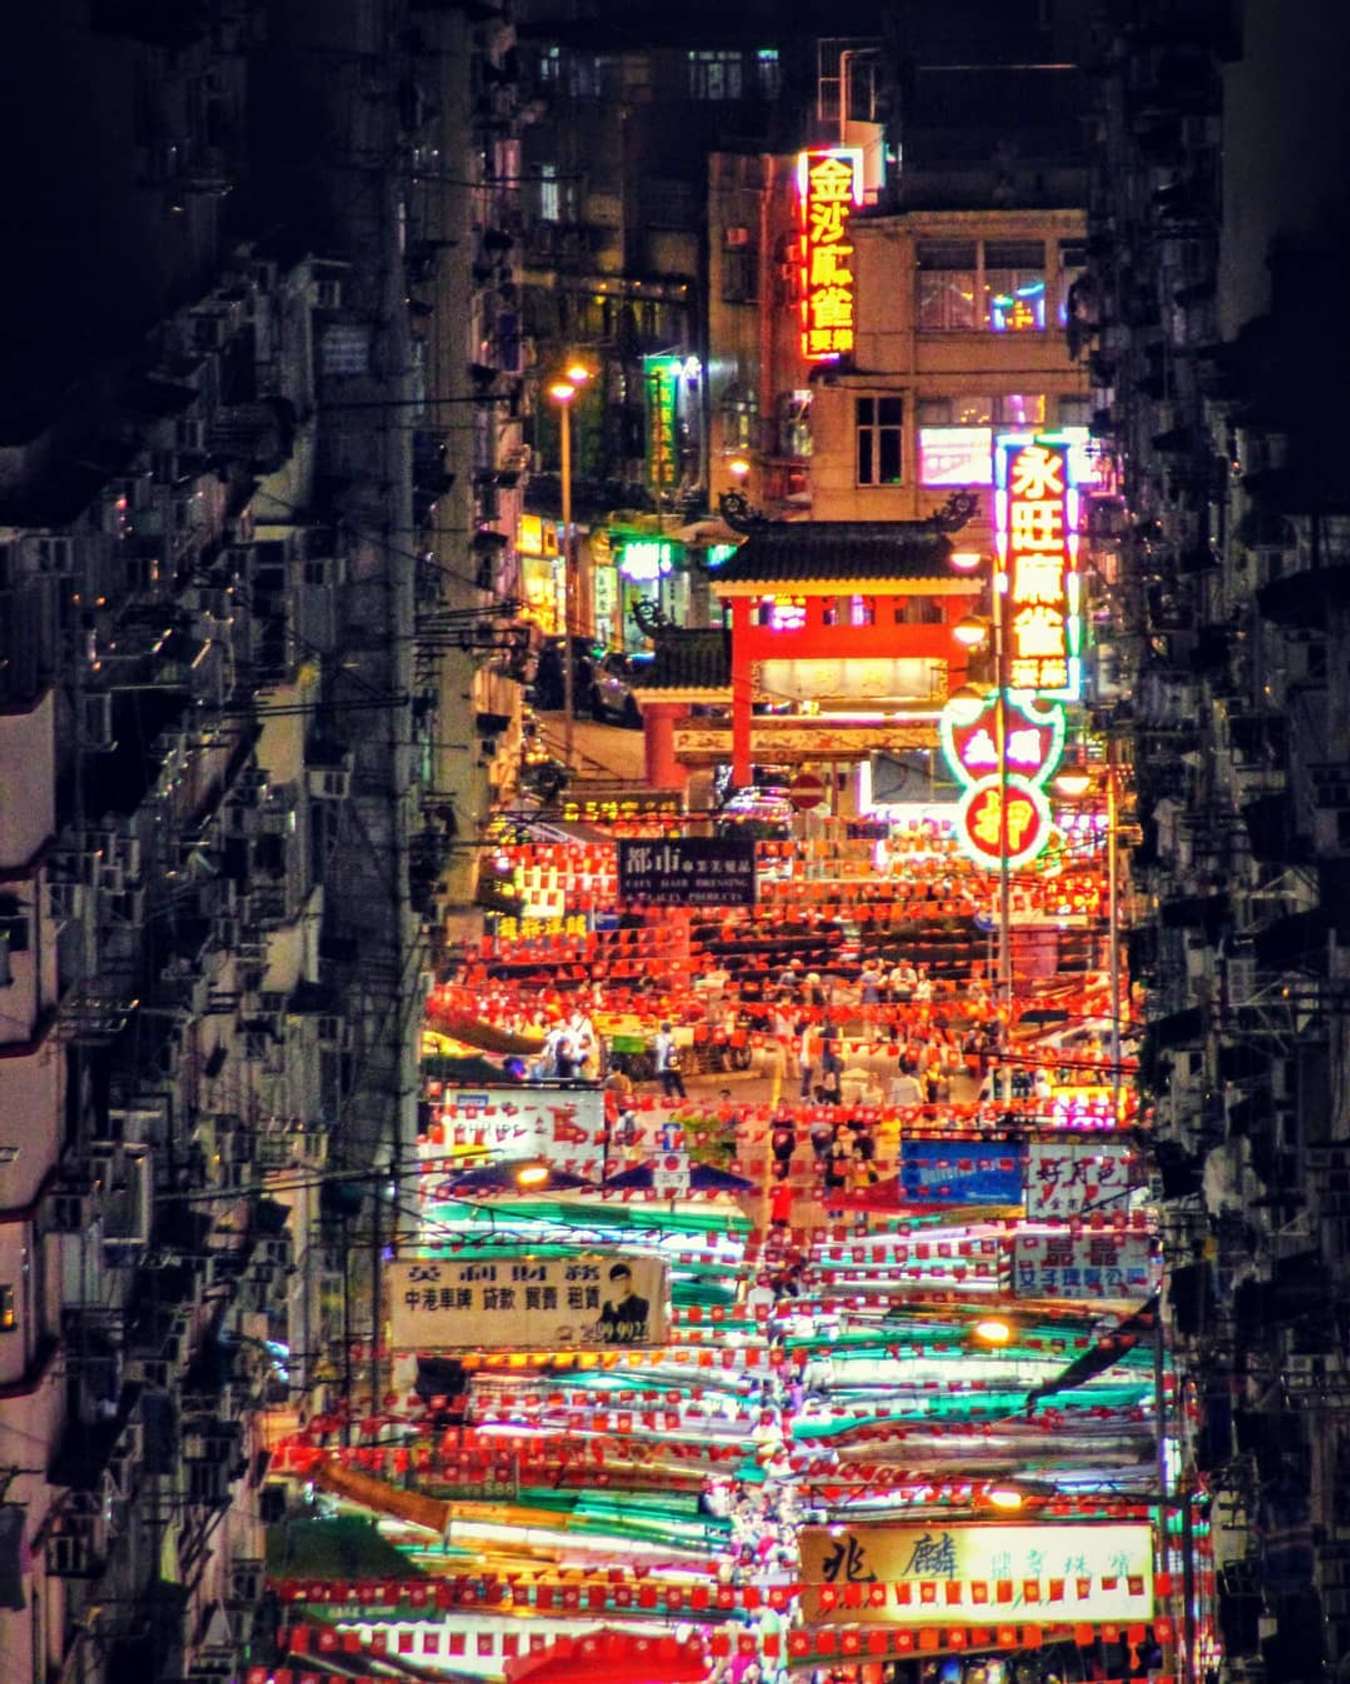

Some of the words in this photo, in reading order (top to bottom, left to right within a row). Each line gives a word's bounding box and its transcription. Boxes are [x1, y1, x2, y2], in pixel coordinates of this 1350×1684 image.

[405, 1287, 472, 1312] 中港車牌
[483, 1286, 516, 1311] 貸款
[567, 1285, 601, 1310] 租賃
